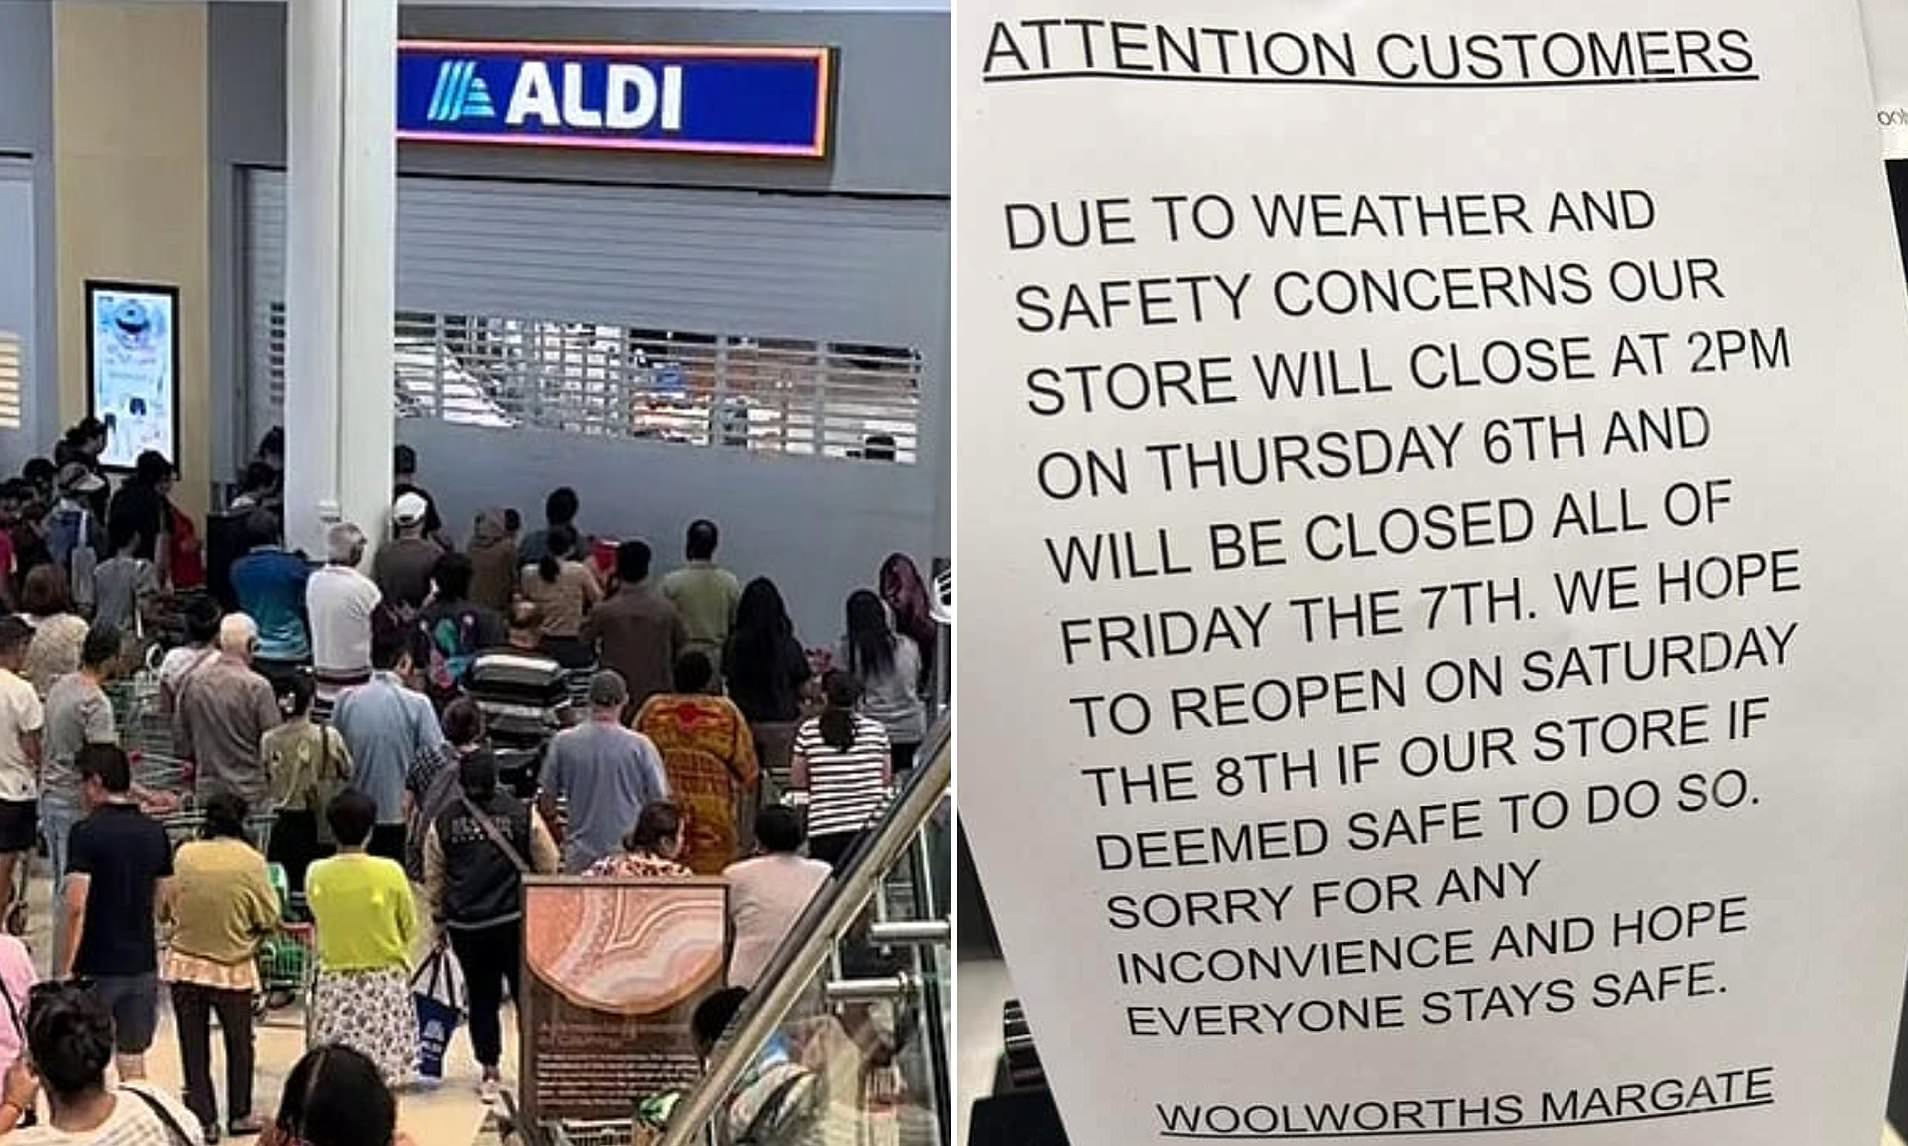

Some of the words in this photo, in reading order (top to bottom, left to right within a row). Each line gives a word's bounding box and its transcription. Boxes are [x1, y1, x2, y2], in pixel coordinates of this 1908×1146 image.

[981, 17, 1358, 78] ATTENTION
[1376, 28, 1753, 81] CUSTOMERS
[504, 61, 682, 129] ALDI
[1003, 197, 1137, 251] DUE
[1150, 193, 1236, 243] TO
[1250, 193, 1534, 239] WEATHER
[1547, 189, 1656, 234] AND
[1015, 272, 1253, 334] SAFETY
[1273, 262, 1593, 318] CONCERNS
[1608, 257, 1727, 304] OUR
[1026, 356, 1239, 417] STORE
[1251, 347, 1393, 401] WILL
[1409, 335, 1597, 391] CLOSE
[1611, 331, 1671, 378] AT
[1687, 326, 1791, 374] 2PM
[1037, 446, 1129, 501] ON
[1144, 421, 1466, 492] THURSDAY
[1483, 412, 1586, 466] 6TH
[1602, 405, 1711, 456] AND
[1043, 527, 1193, 585] WILL
[1208, 518, 1288, 572] BE
[1304, 497, 1535, 563] CLOSED
[1551, 487, 1649, 539] ALL
[1663, 478, 1733, 528] OF
[1060, 601, 1273, 666] FRIDAY
[1288, 589, 1404, 644] THE
[1419, 576, 1537, 631] 7TH.
[1552, 563, 1641, 616] WE
[1657, 548, 1802, 606] HOPE
[1068, 692, 1152, 739] TO
[1169, 665, 1407, 732] REOPEN
[1425, 654, 1503, 704] ON
[1521, 621, 1799, 693] SATURDAY
[1080, 760, 1199, 807] THE
[1215, 747, 1318, 798] 8TH
[1337, 740, 1382, 787] IF
[1399, 726, 1518, 778] OUR
[1533, 703, 1711, 762] STORE
[1728, 696, 1770, 741] IF
[1095, 817, 1329, 871] DEEMED
[1347, 798, 1484, 852] SAFE
[1498, 789, 1570, 834] TO
[1587, 778, 1661, 825] DO
[1676, 768, 1759, 813] SO.
[1106, 883, 1295, 930] SORRY
[1311, 873, 1423, 919] FOR
[1434, 858, 1542, 907] ANY
[1117, 928, 1475, 986] INCONVIENCE
[1489, 916, 1595, 963] AND
[1612, 895, 1748, 949] HOPE
[1126, 994, 1406, 1037] EVERYONE
[1421, 977, 1576, 1025] STAYS
[1591, 960, 1727, 1009] SAFE.
[1155, 1094, 1524, 1133] WOOLWORTHS
[1540, 1066, 1774, 1123] MARGATE
